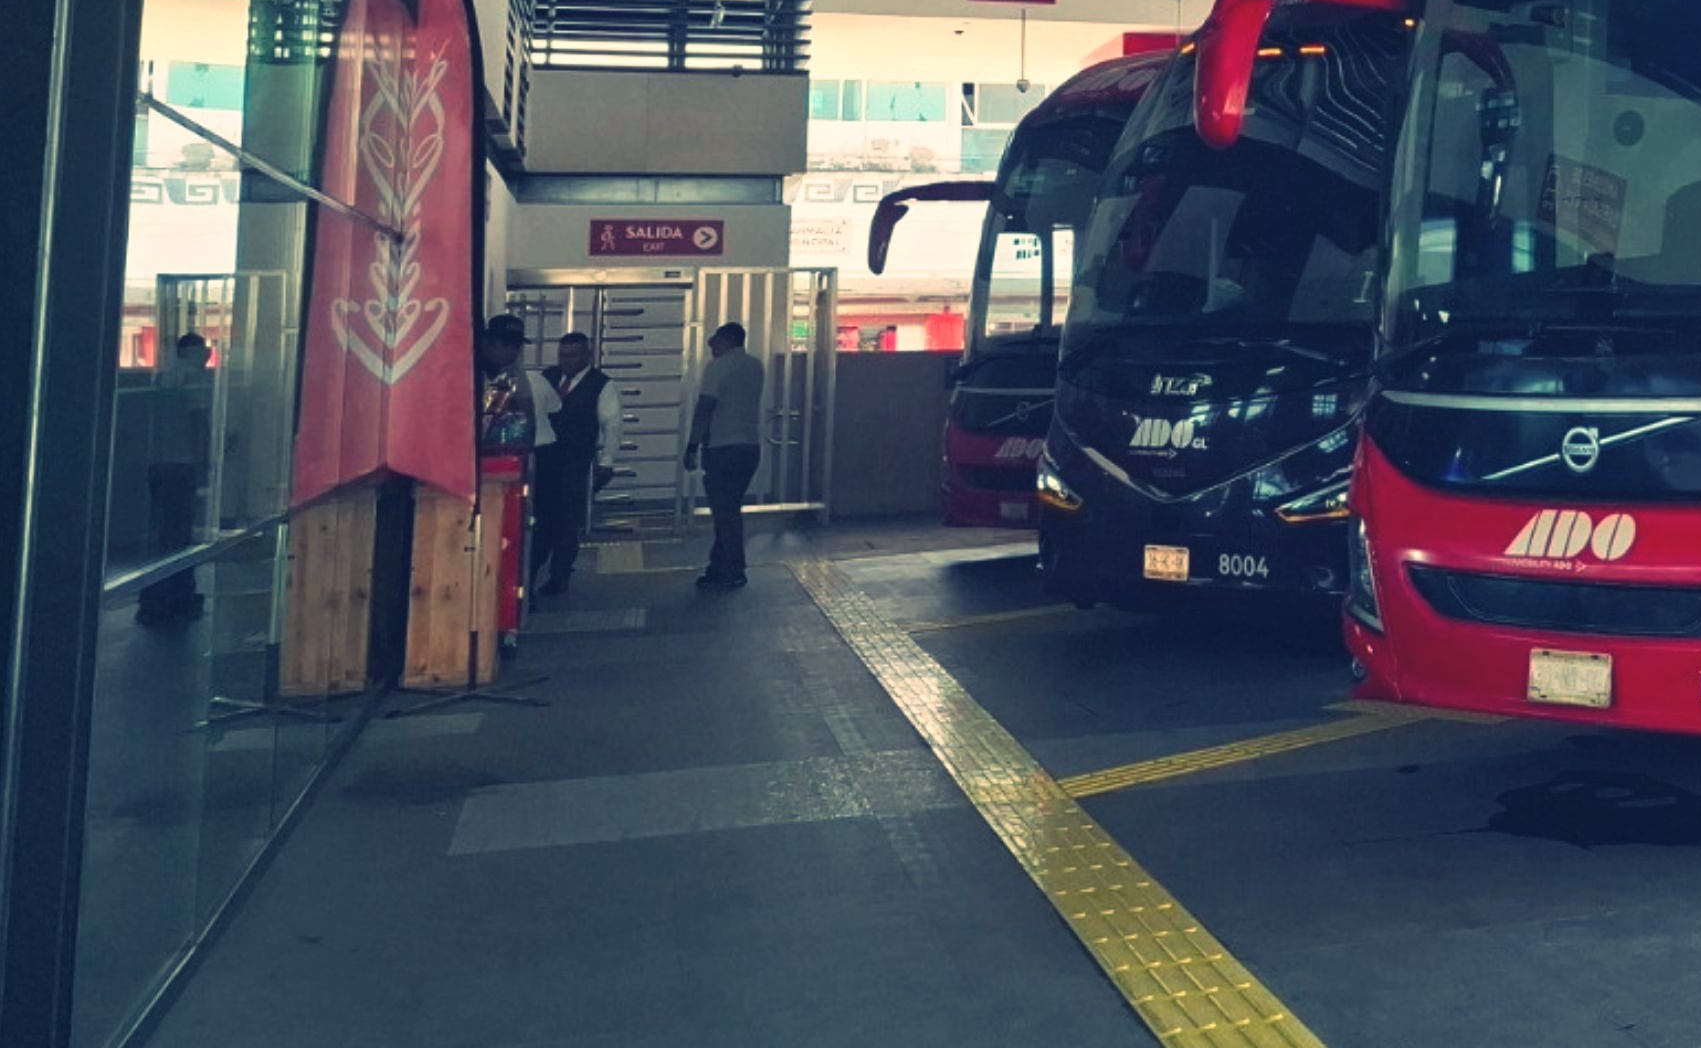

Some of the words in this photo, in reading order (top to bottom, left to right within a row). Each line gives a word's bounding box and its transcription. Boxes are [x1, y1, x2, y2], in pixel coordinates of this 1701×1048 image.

[625, 225, 683, 240] SALIDA
[643, 242, 665, 252] EXIT
[1128, 418, 1193, 449] ADO
[1503, 509, 1636, 562] ADO
[1218, 553, 1270, 578] 8004
